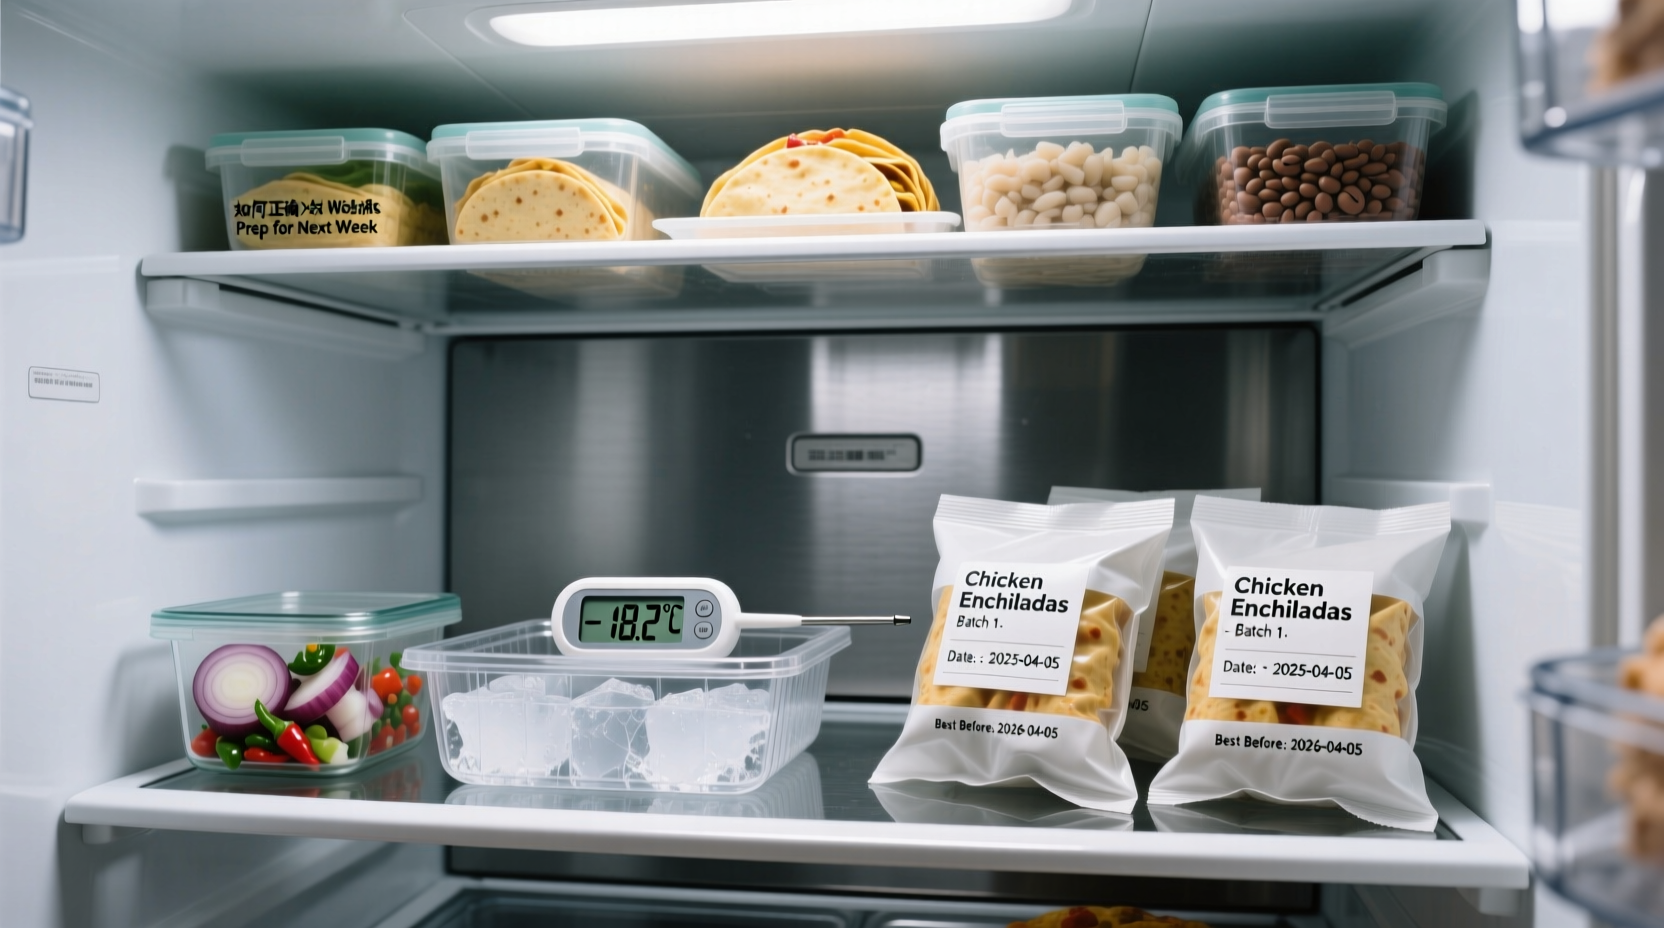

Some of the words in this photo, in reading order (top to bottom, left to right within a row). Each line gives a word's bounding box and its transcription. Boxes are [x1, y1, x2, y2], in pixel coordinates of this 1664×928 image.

[236, 221, 269, 240] Prep
[273, 220, 294, 235] for
[298, 220, 332, 234] Next
[336, 220, 378, 234] Week
[965, 570, 1044, 590] Chicken
[1234, 576, 1324, 597] Chicken
[959, 591, 1069, 613] Enchiladas
[1230, 598, 1352, 621] Enchiladas
[956, 615, 989, 629] Batch
[1235, 623, 1272, 638] Batch
[988, 652, 1060, 669] 2025-04-05
[1223, 660, 1257, 674] Date:
[1272, 662, 1353, 681] 2025-04-05
[934, 718, 957, 730] Best
[1215, 734, 1240, 747] Best
[1244, 735, 1287, 750] Before:
[1290, 738, 1363, 756] 2026-04-05
